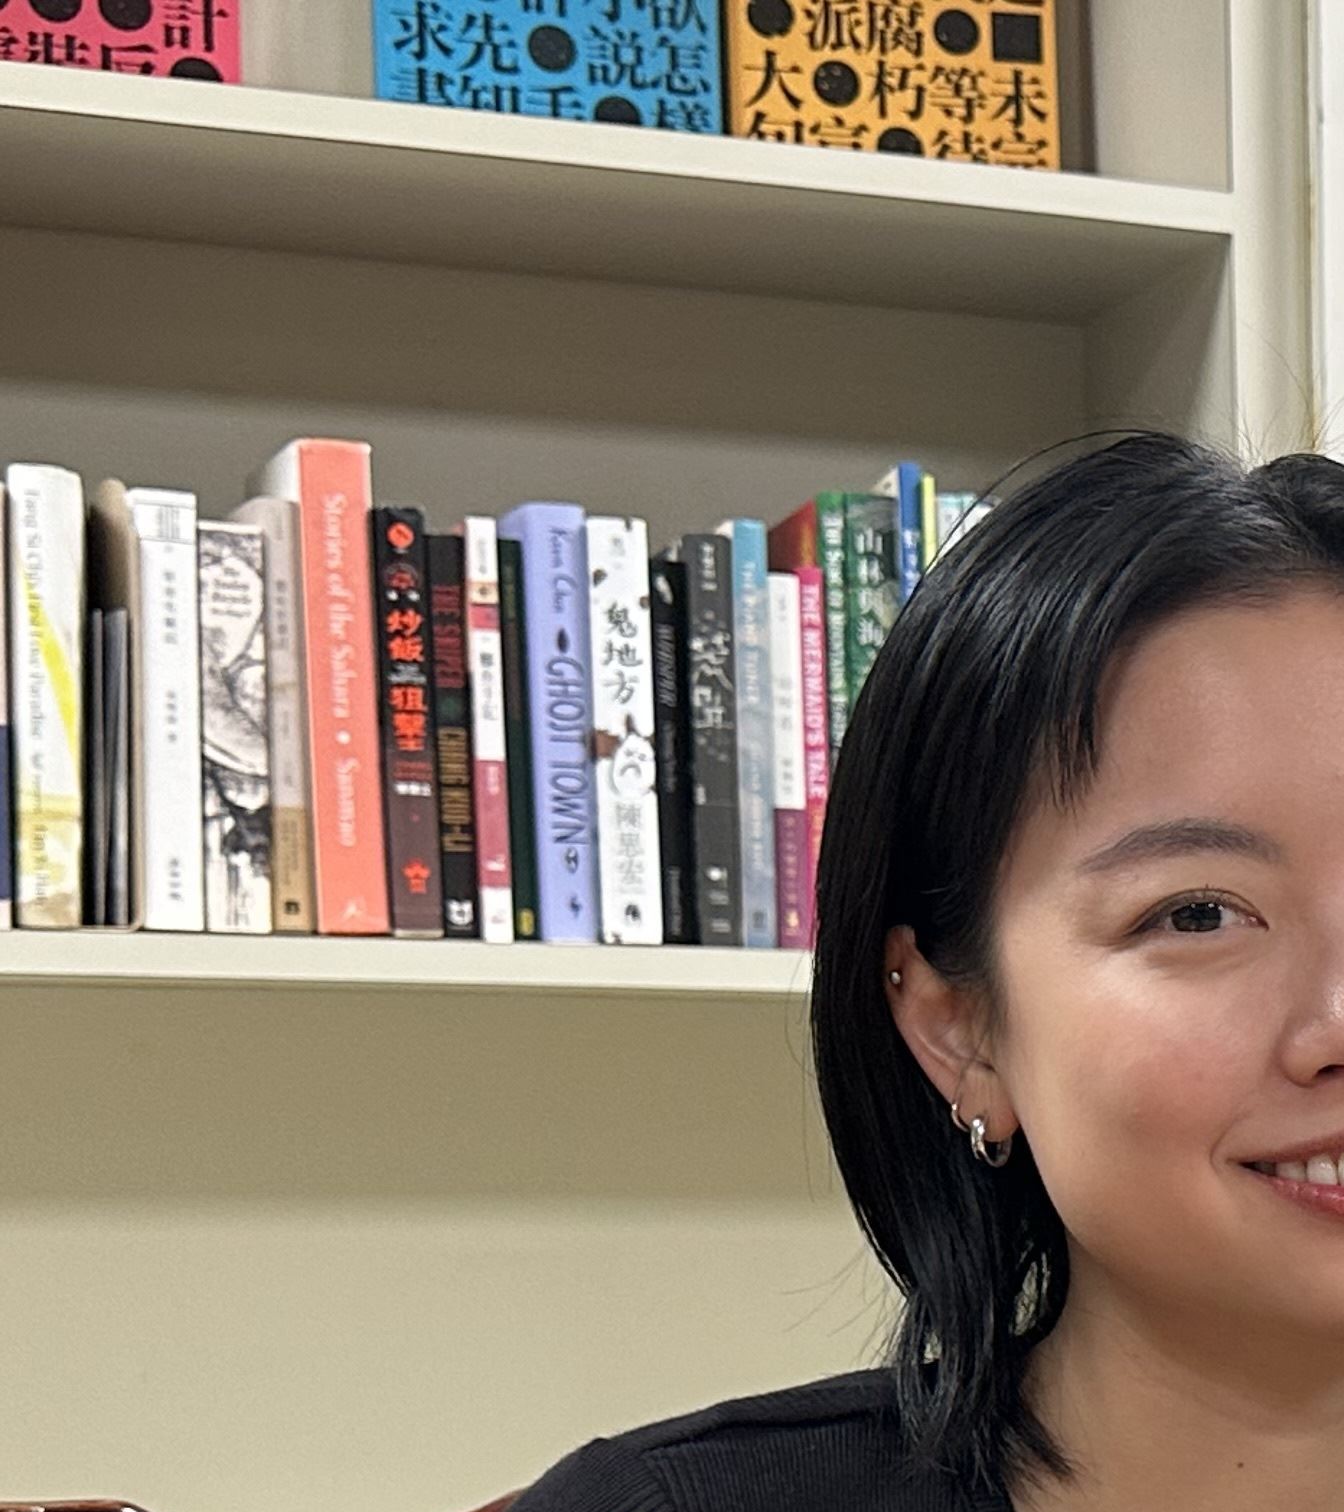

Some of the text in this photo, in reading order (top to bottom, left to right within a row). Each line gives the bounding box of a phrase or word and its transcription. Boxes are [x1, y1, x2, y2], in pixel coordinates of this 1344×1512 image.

[323, 493, 358, 718] Stories of the Sahara
[801, 583, 821, 625] THE
[803, 629, 826, 746] MERMAID'S
[335, 757, 361, 847] Sanmao
[545, 658, 591, 845] GHOST TOWN
[807, 749, 829, 799] TALE
